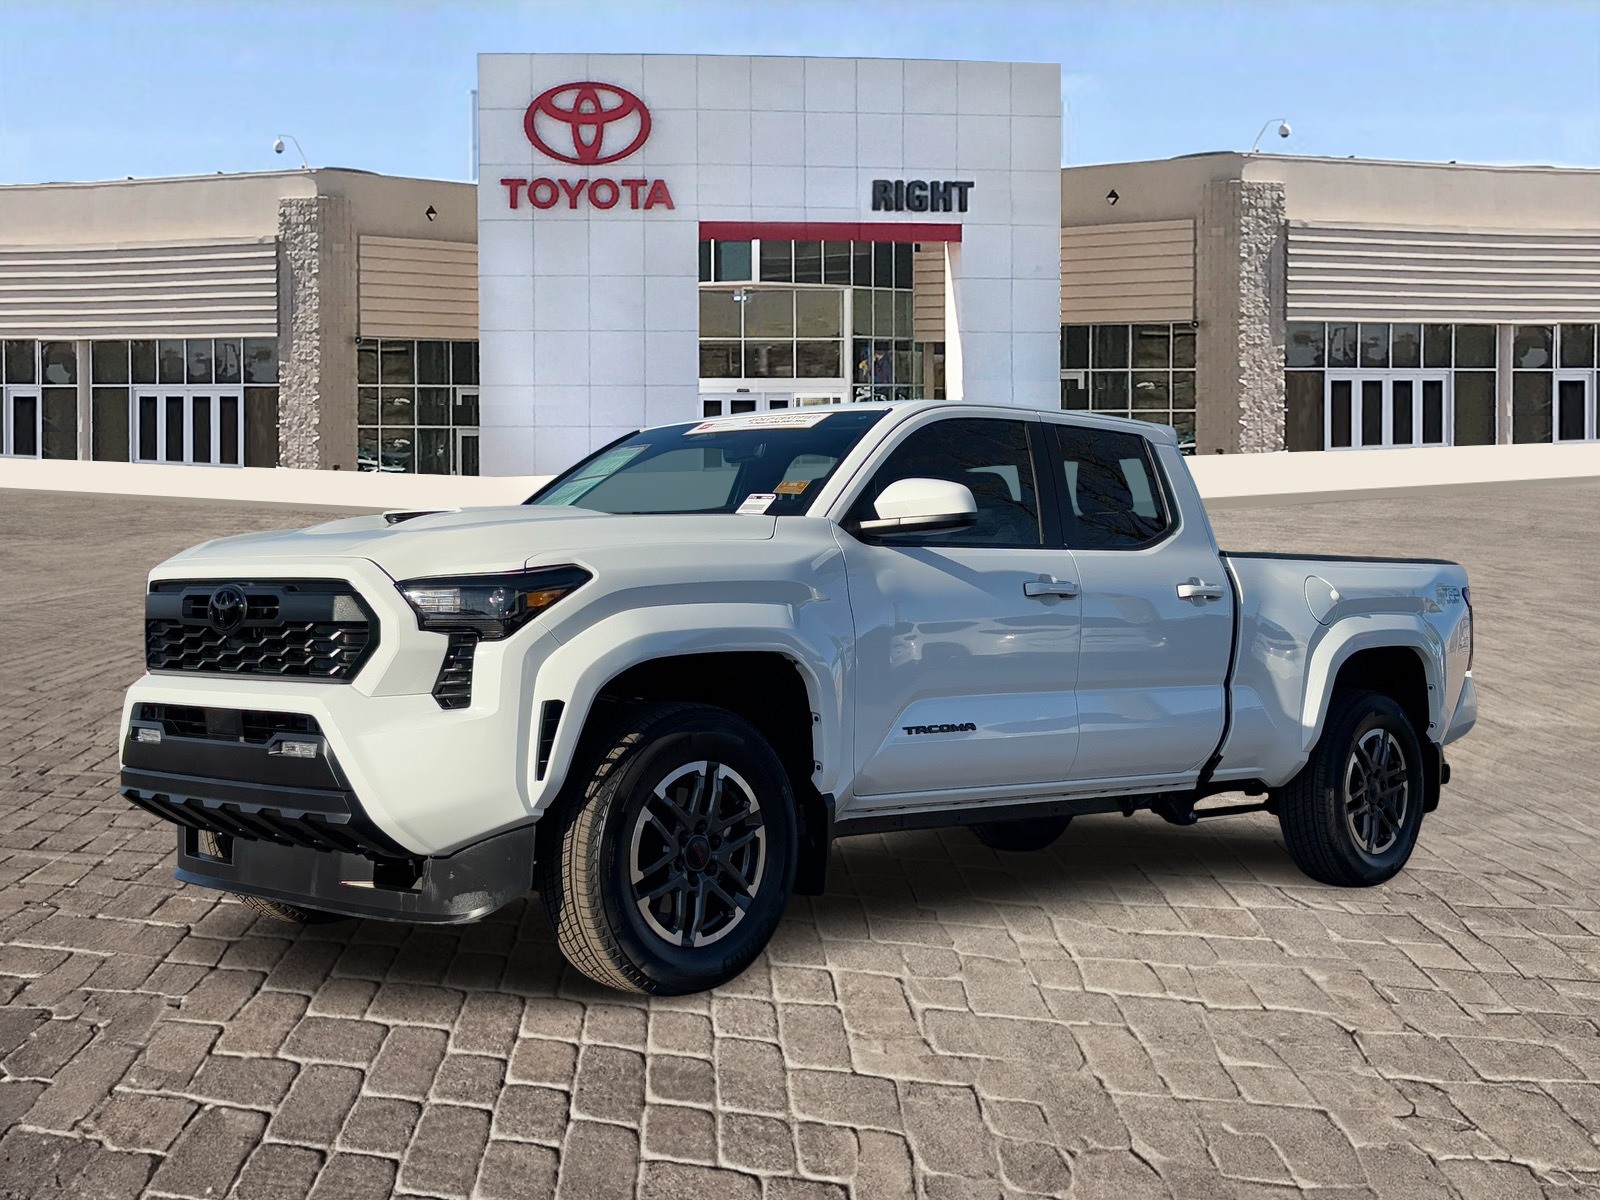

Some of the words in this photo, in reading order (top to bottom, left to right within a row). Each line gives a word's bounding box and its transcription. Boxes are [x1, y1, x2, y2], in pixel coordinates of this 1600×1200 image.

[500, 177, 675, 210] TOYOTA
[872, 180, 975, 212] RIGHT
[902, 722, 977, 735] TACOMA
